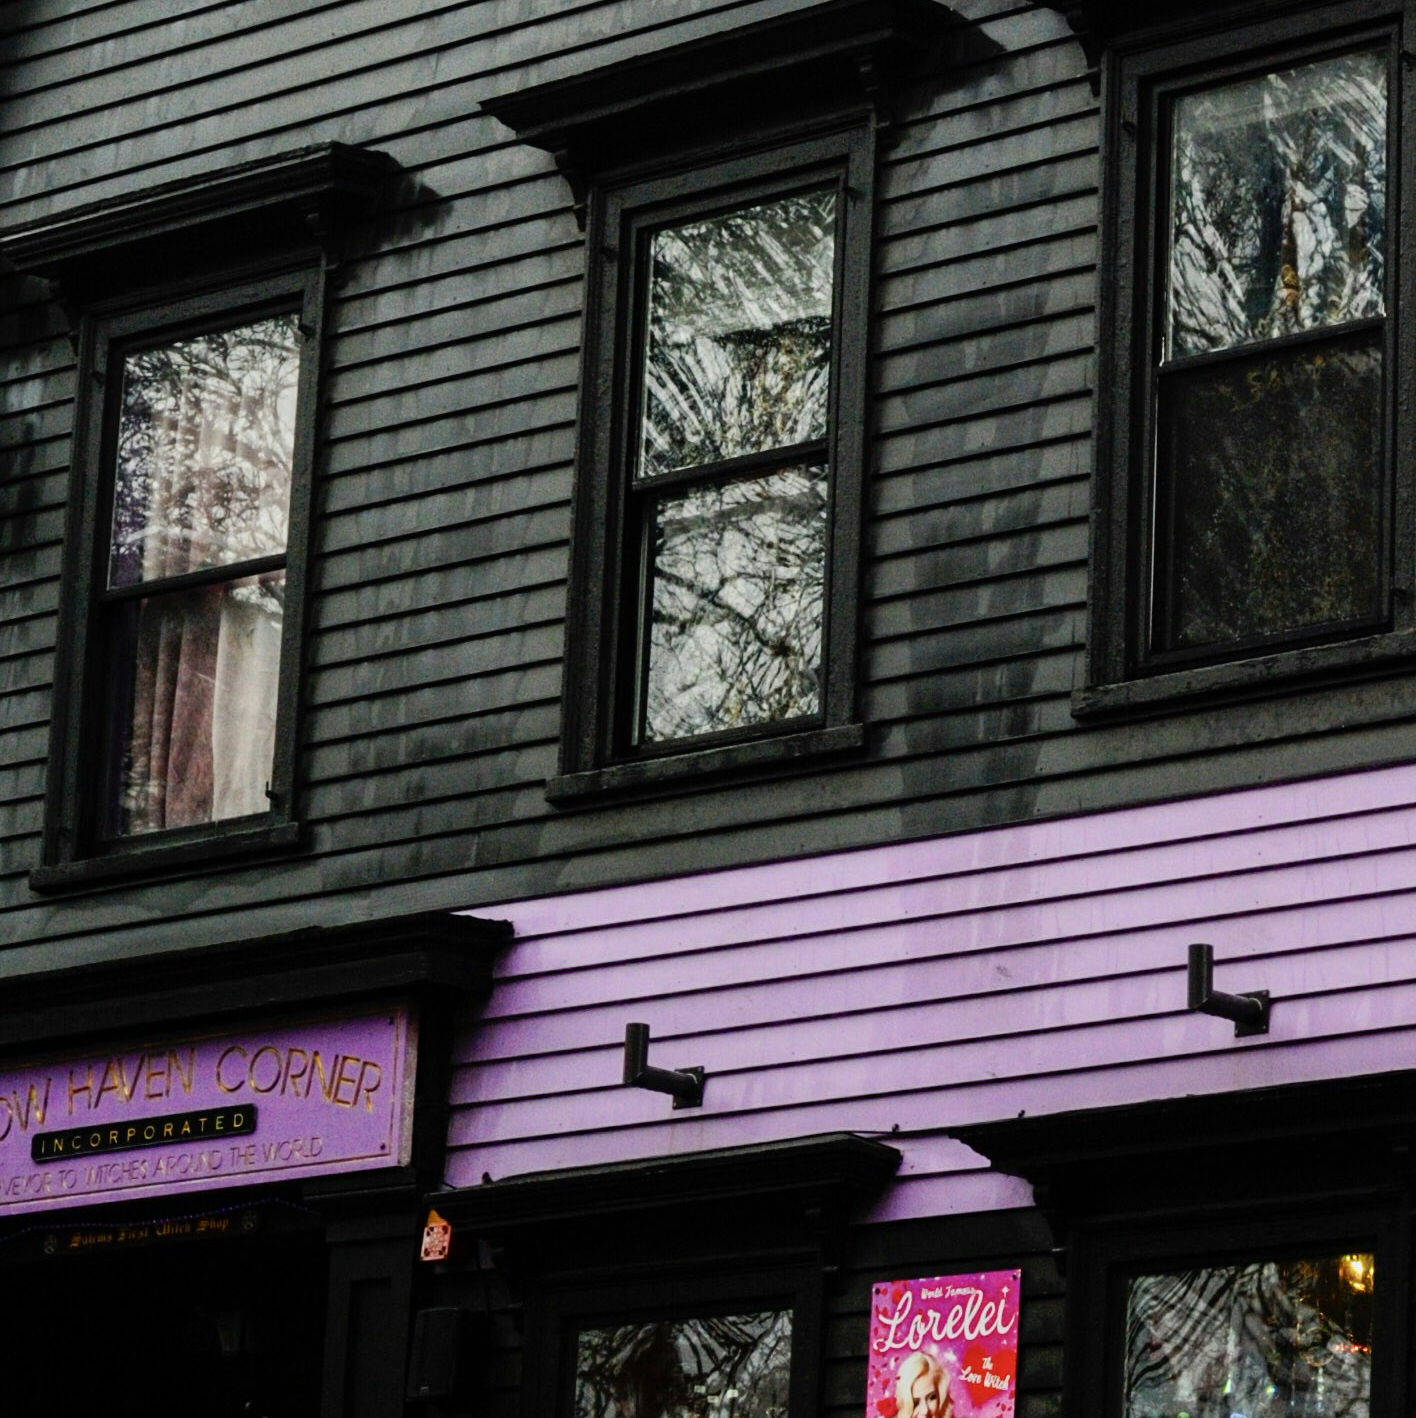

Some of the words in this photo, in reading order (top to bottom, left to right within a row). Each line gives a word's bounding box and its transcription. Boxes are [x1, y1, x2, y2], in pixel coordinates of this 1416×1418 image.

[67, 1047, 196, 1115] HAVEN
[215, 1045, 383, 1113] CORNER
[41, 1113, 244, 1154] INCORPORATED
[0, 1172, 52, 1196] VEYOR
[58, 1168, 77, 1189] TO
[84, 1158, 149, 1186] WITCHES
[152, 1149, 223, 1178] AROUND
[230, 1144, 256, 1168] THE
[262, 1137, 323, 1163] WORLD
[196, 1217, 229, 1232] Shop
[873, 1285, 1016, 1353] Lorelei
[960, 1366, 982, 1384] Love
